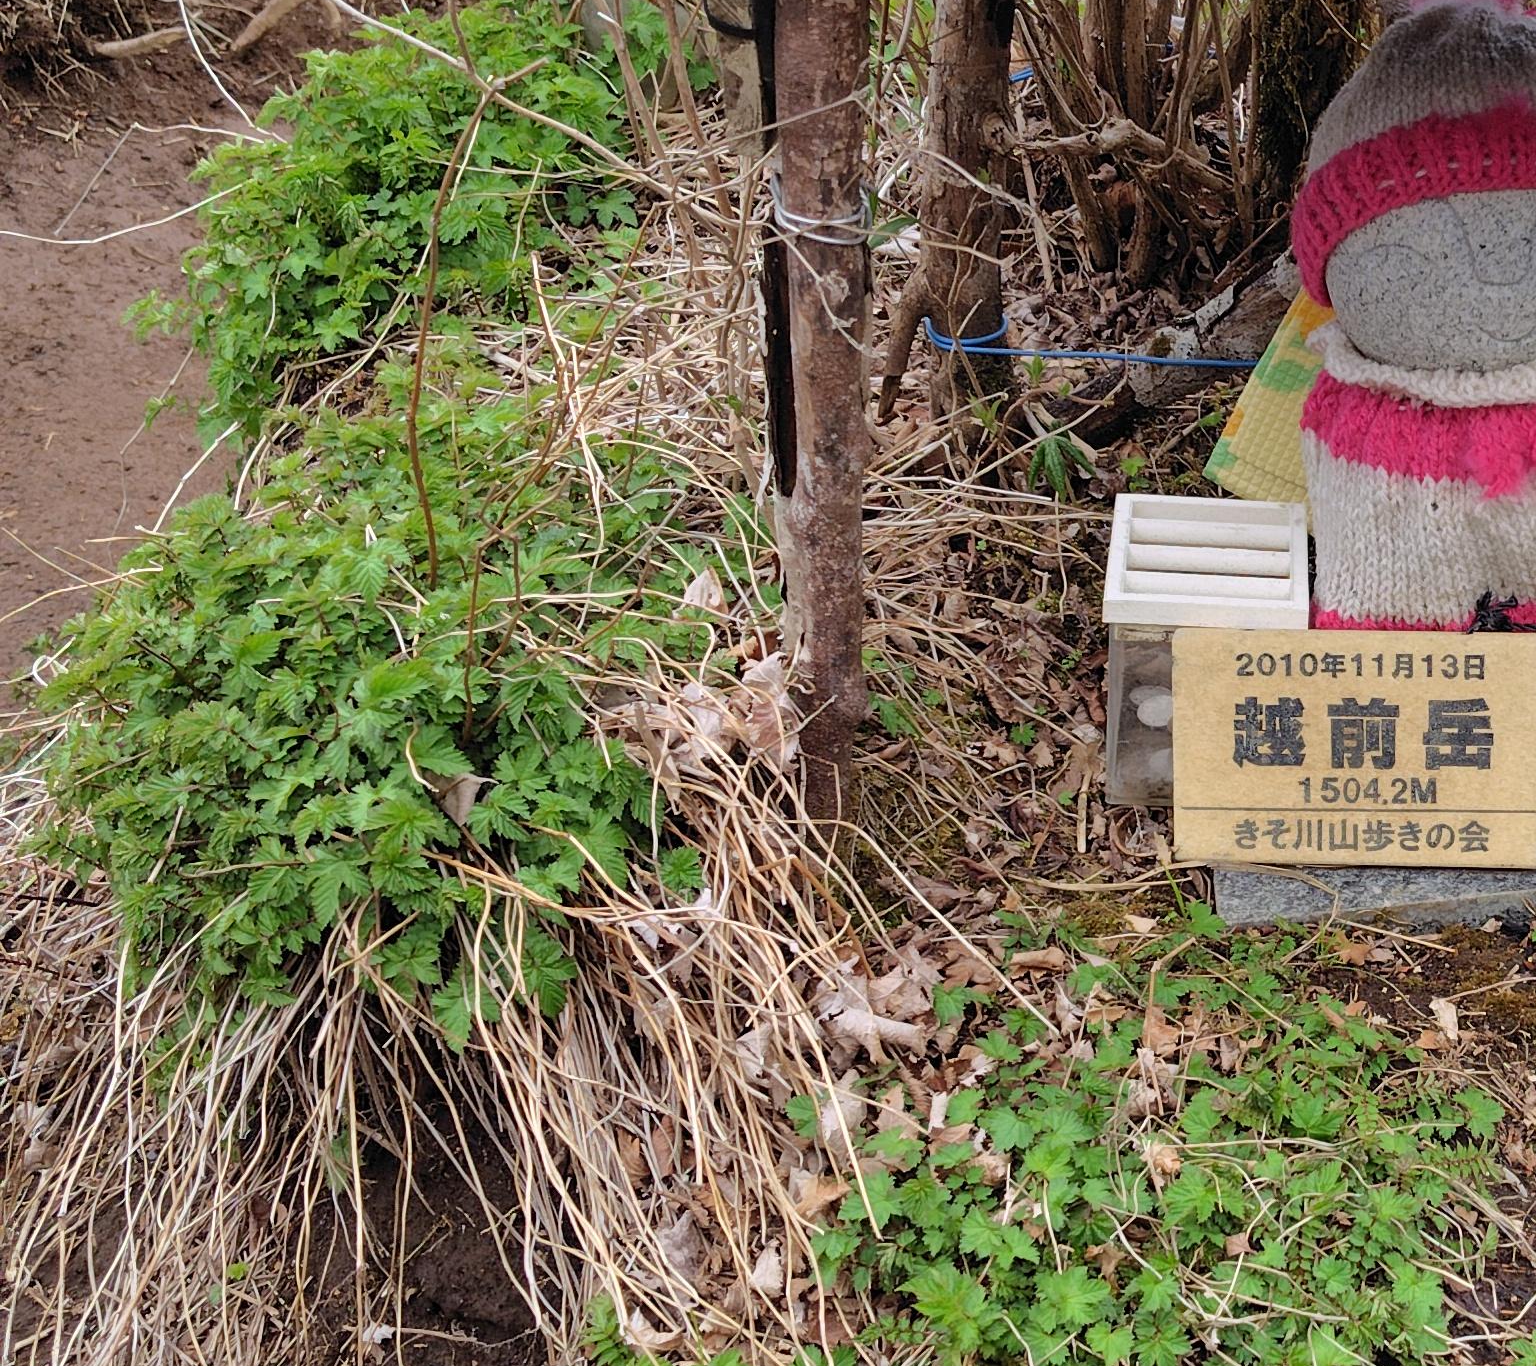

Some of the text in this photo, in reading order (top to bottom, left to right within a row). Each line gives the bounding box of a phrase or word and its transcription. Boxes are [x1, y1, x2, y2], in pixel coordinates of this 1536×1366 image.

[1235, 651, 1486, 681] 2010年11月13日
[1232, 696, 1495, 771] 越前岳
[1298, 776, 1438, 804] 1504.2M
[1234, 817, 1491, 853] きそ川山歩きの会
